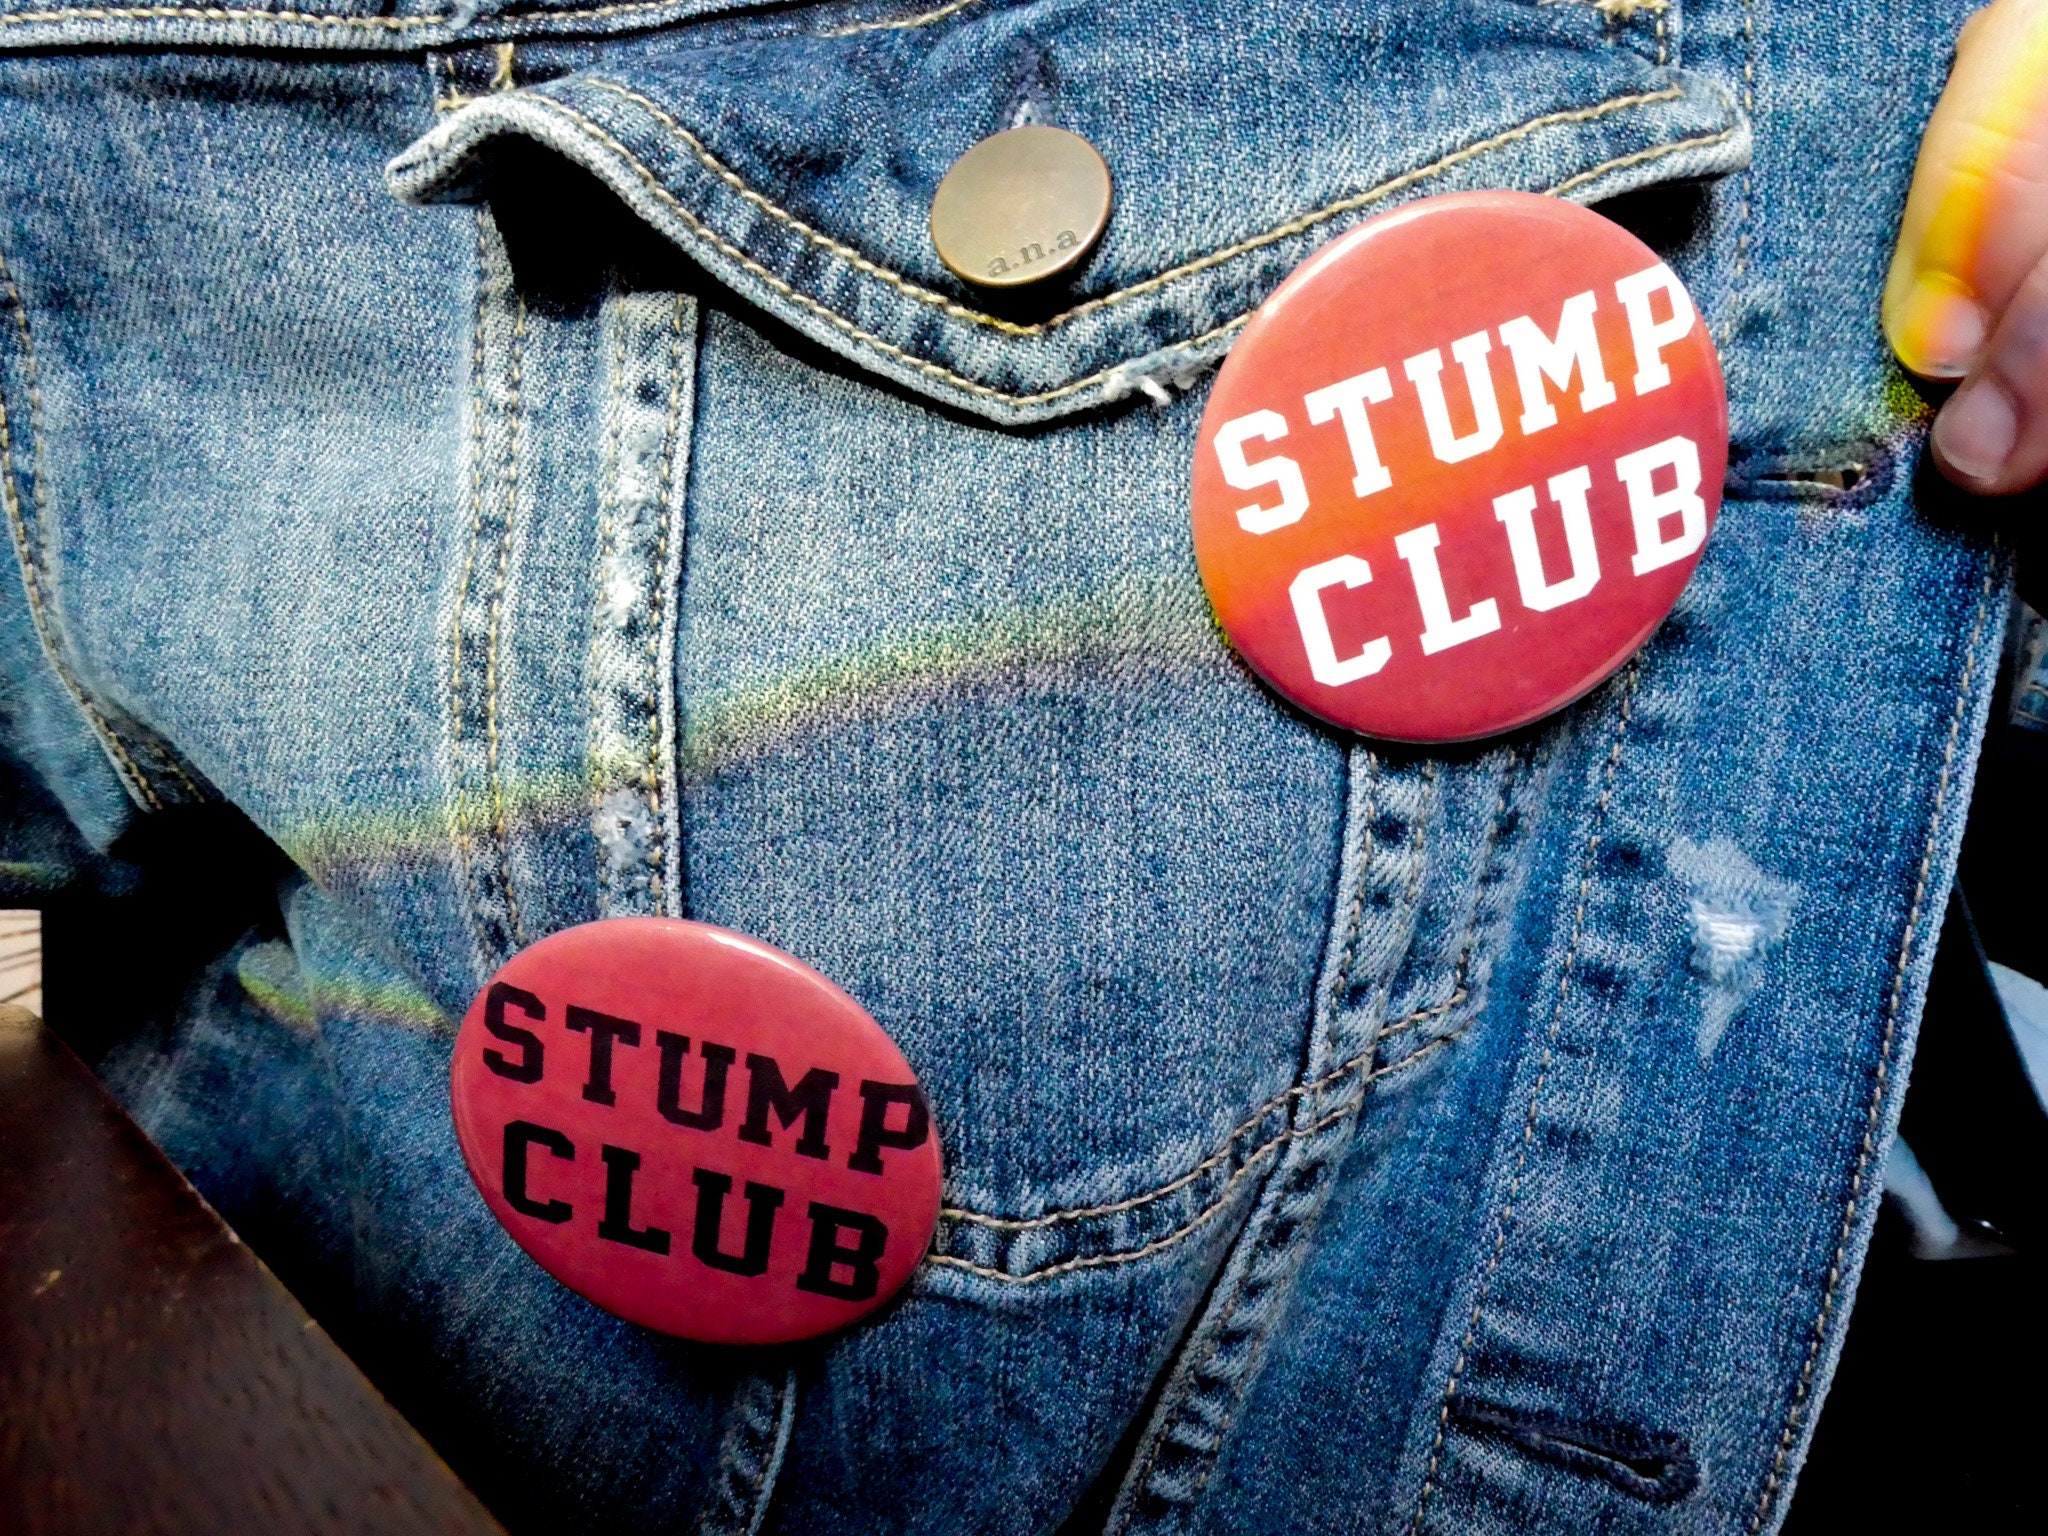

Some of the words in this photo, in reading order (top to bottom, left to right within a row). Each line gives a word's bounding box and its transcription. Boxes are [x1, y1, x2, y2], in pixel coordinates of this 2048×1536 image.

[987, 230, 1080, 277] a.n.a
[1213, 262, 1696, 535] STUMP
[1288, 435, 1708, 687] CLUB
[482, 981, 929, 1176] STUMP
[503, 1120, 889, 1301] CLUB
